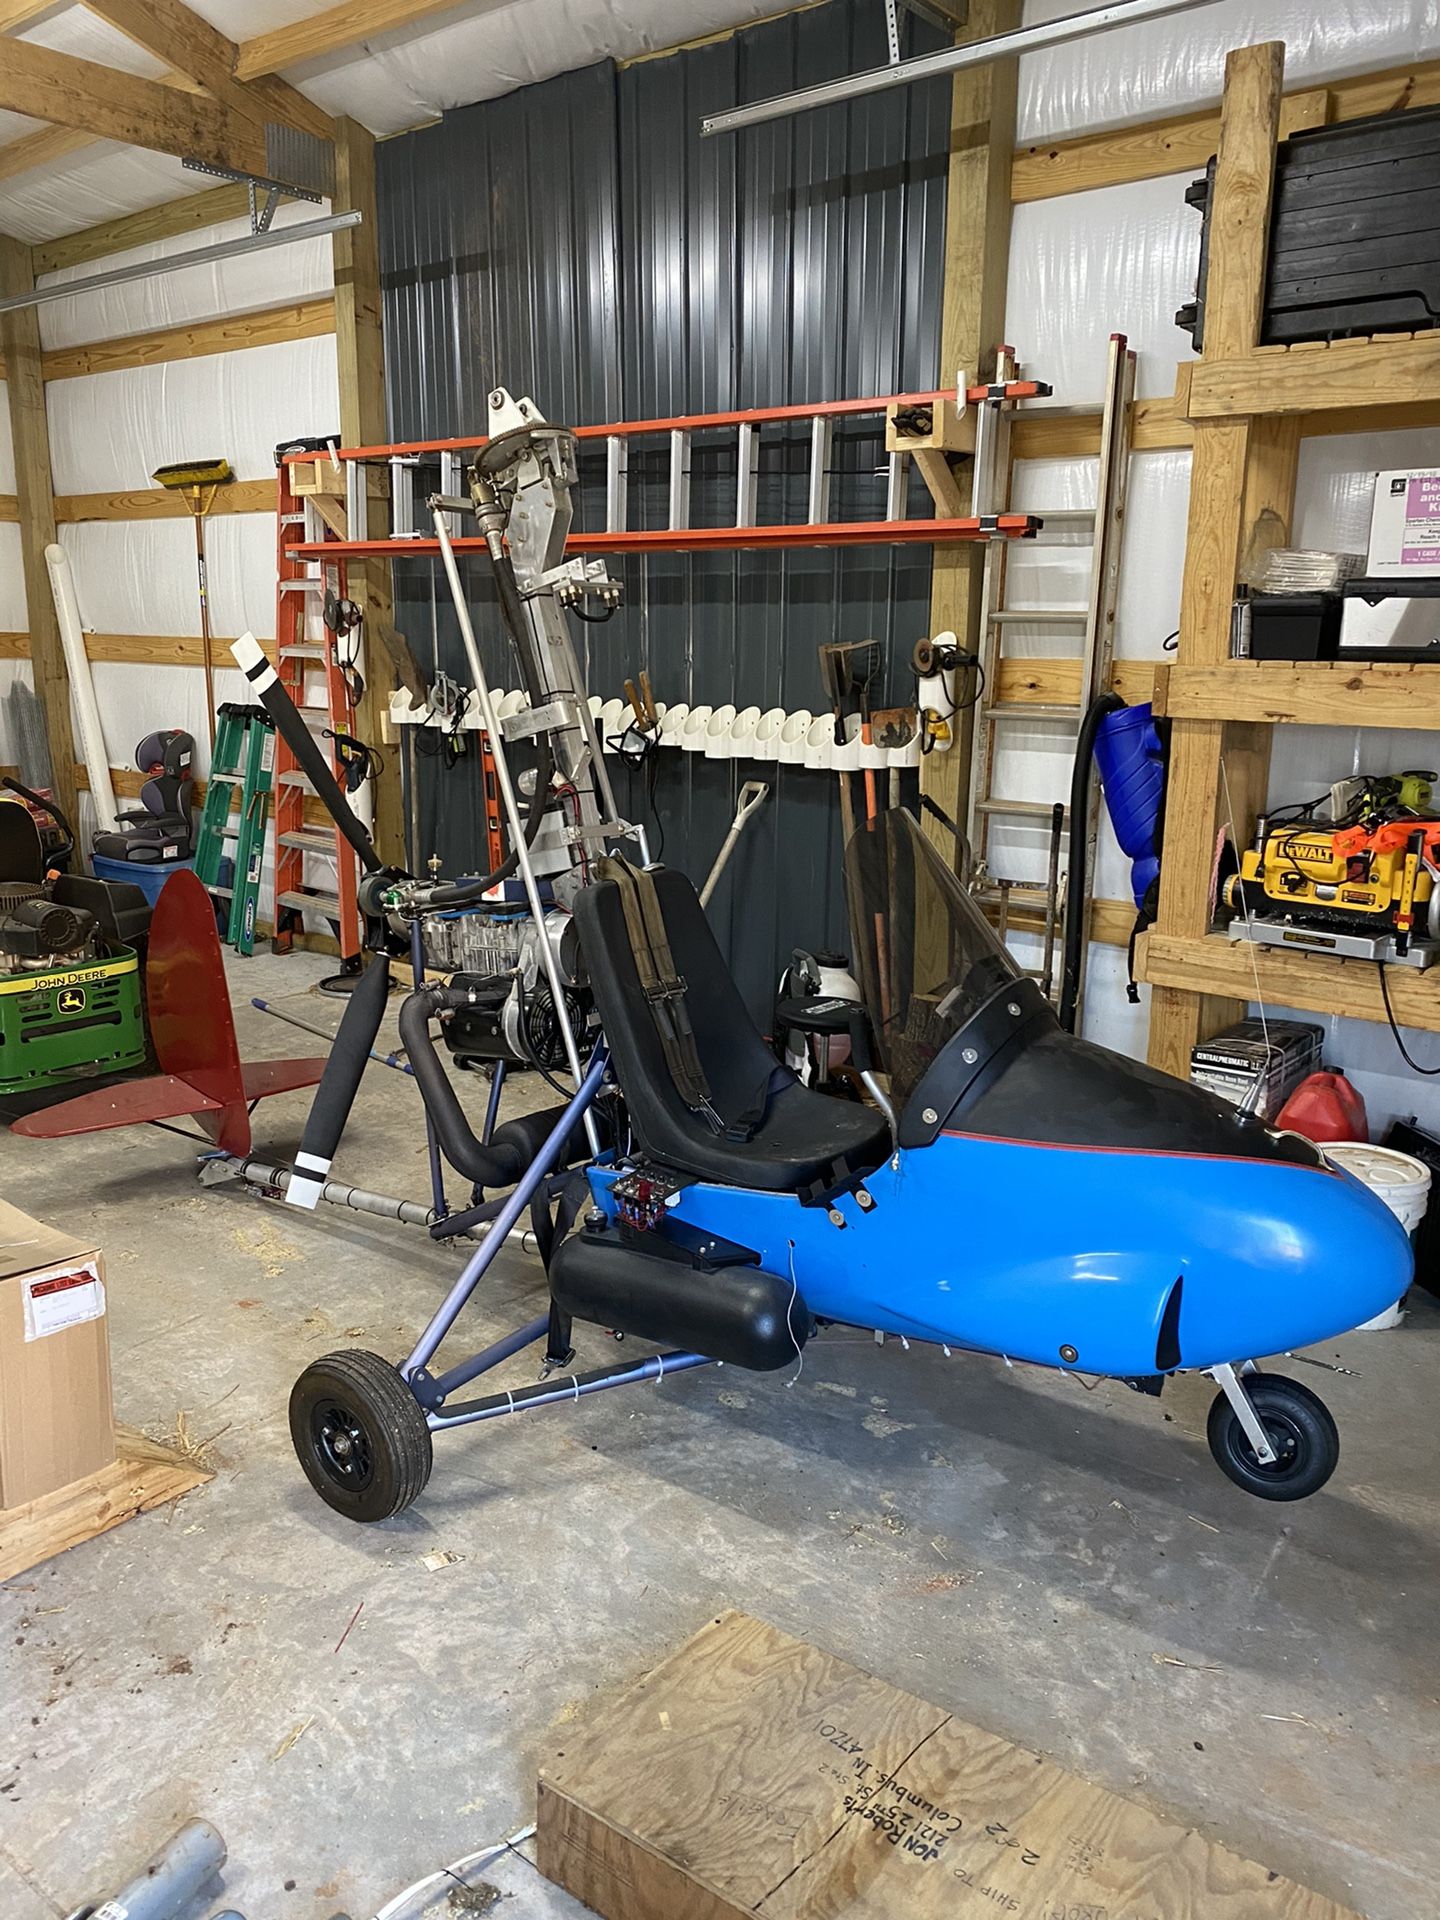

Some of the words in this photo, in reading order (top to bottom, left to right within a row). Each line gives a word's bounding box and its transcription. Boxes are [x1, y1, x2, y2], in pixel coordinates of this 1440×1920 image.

[31, 976, 66, 990] JOHN
[67, 969, 107, 984] DEERE
[812, 1719, 863, 1754] 47201
[843, 1796, 907, 1846] Roberts
[985, 1822, 1008, 1836] 2
[913, 1821, 949, 1847] 2121
[1021, 1848, 1040, 1866] 2
[953, 1869, 974, 1888] TO
[981, 1887, 1020, 1911] SHIP
